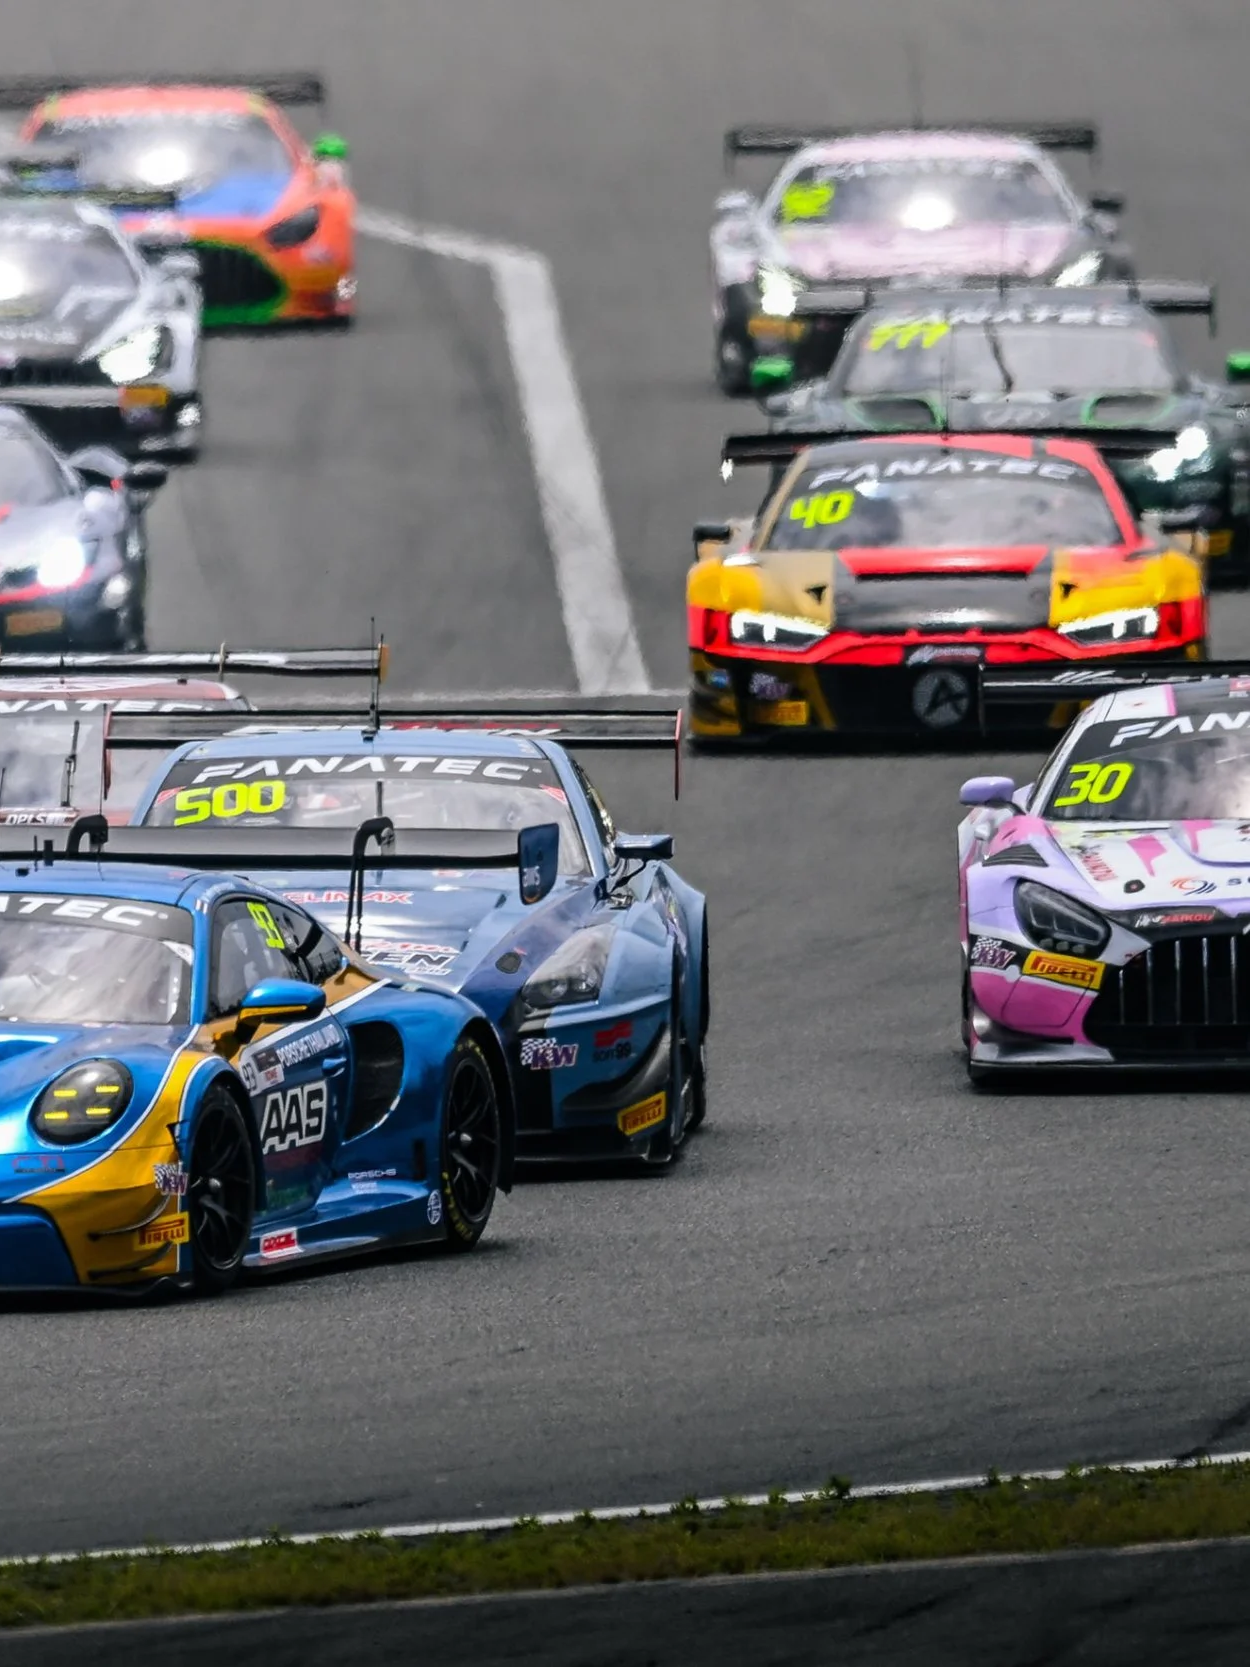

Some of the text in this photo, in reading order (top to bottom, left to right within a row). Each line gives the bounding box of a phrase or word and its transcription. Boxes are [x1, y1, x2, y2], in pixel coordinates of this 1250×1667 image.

[808, 458, 1079, 489] FANATEC
[790, 490, 856, 528] 40
[1109, 711, 1250, 748] FAN
[192, 756, 531, 783] FANATEC
[1054, 762, 1135, 808] 30
[174, 780, 286, 827] 500
[1030, 955, 1098, 983] PIRELLI
[260, 1082, 327, 1155] AAS
[348, 1168, 397, 1180] PORSCHE
[138, 1218, 185, 1247] PIRELLI
